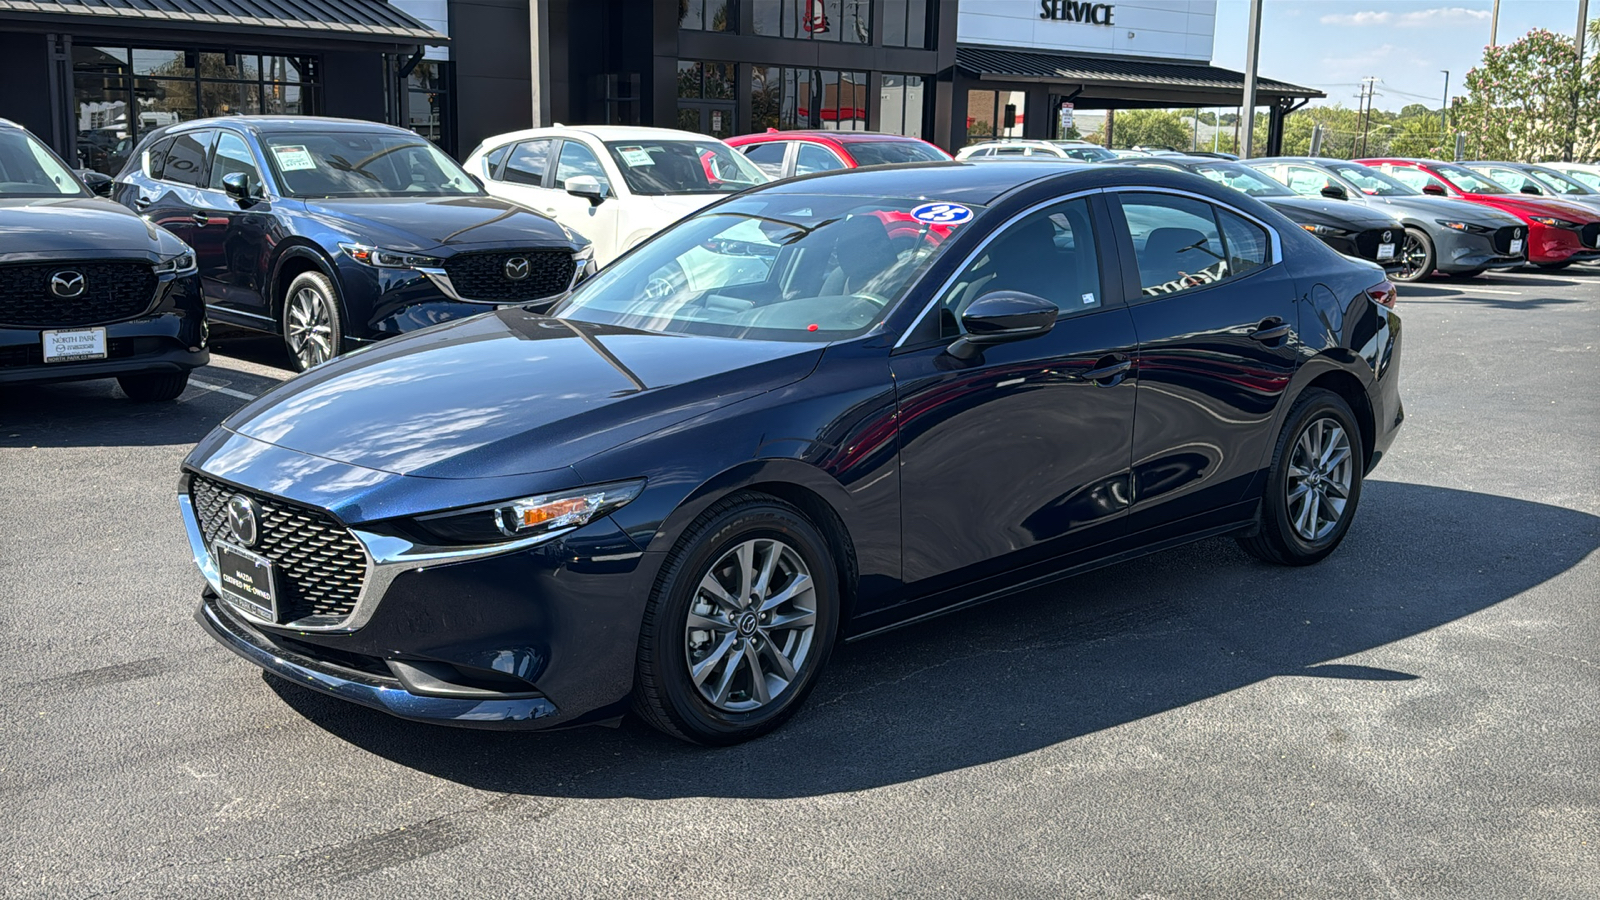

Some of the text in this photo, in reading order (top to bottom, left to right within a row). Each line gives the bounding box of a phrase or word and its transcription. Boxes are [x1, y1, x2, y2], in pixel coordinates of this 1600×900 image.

[1040, 0, 1115, 25] SERVICE
[918, 205, 967, 221] 25
[52, 335, 77, 344] NORTH
[236, 570, 253, 584] MAZDA
[223, 574, 271, 600] CERTIFIED PRE-OWNED
